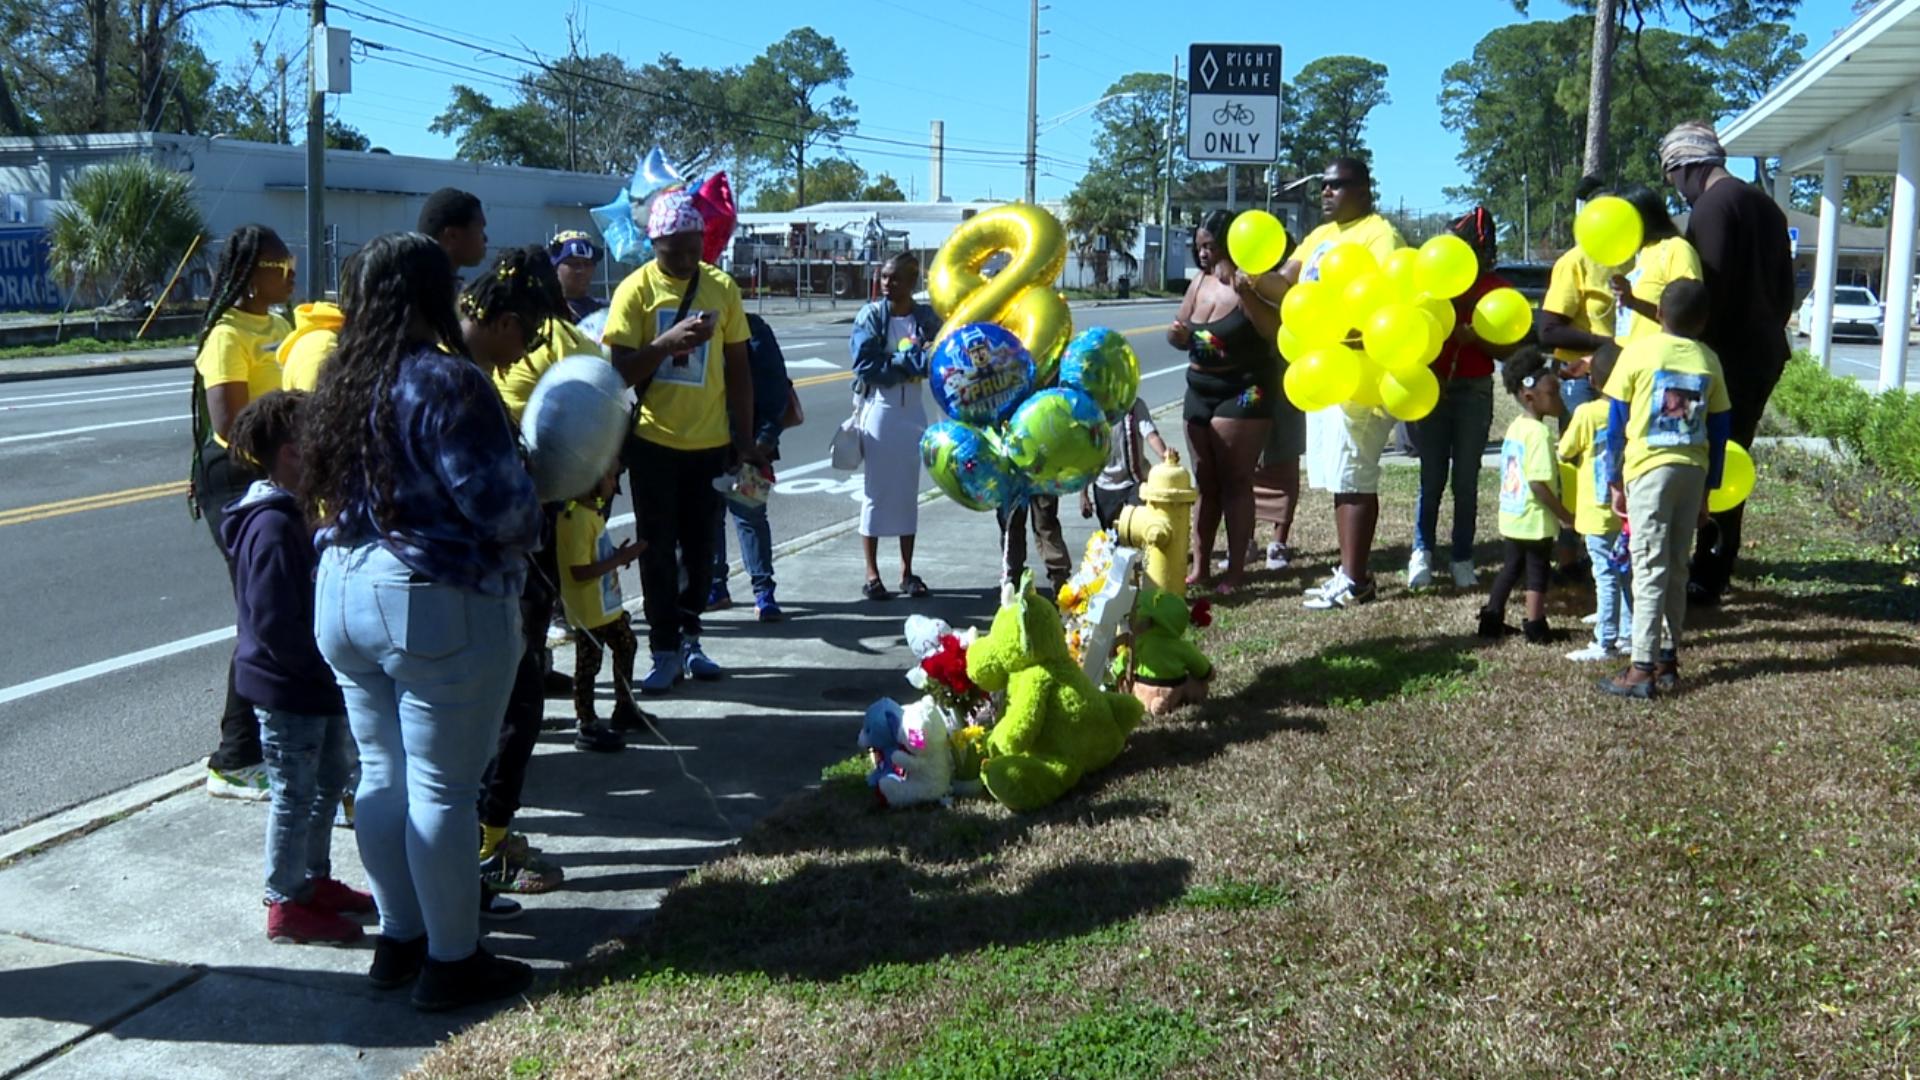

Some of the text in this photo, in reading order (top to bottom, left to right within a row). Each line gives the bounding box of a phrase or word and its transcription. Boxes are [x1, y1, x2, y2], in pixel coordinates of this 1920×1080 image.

[1226, 51, 1273, 67] RIGHT
[1228, 71, 1271, 88] LANE
[1204, 131, 1260, 155] ONLY
